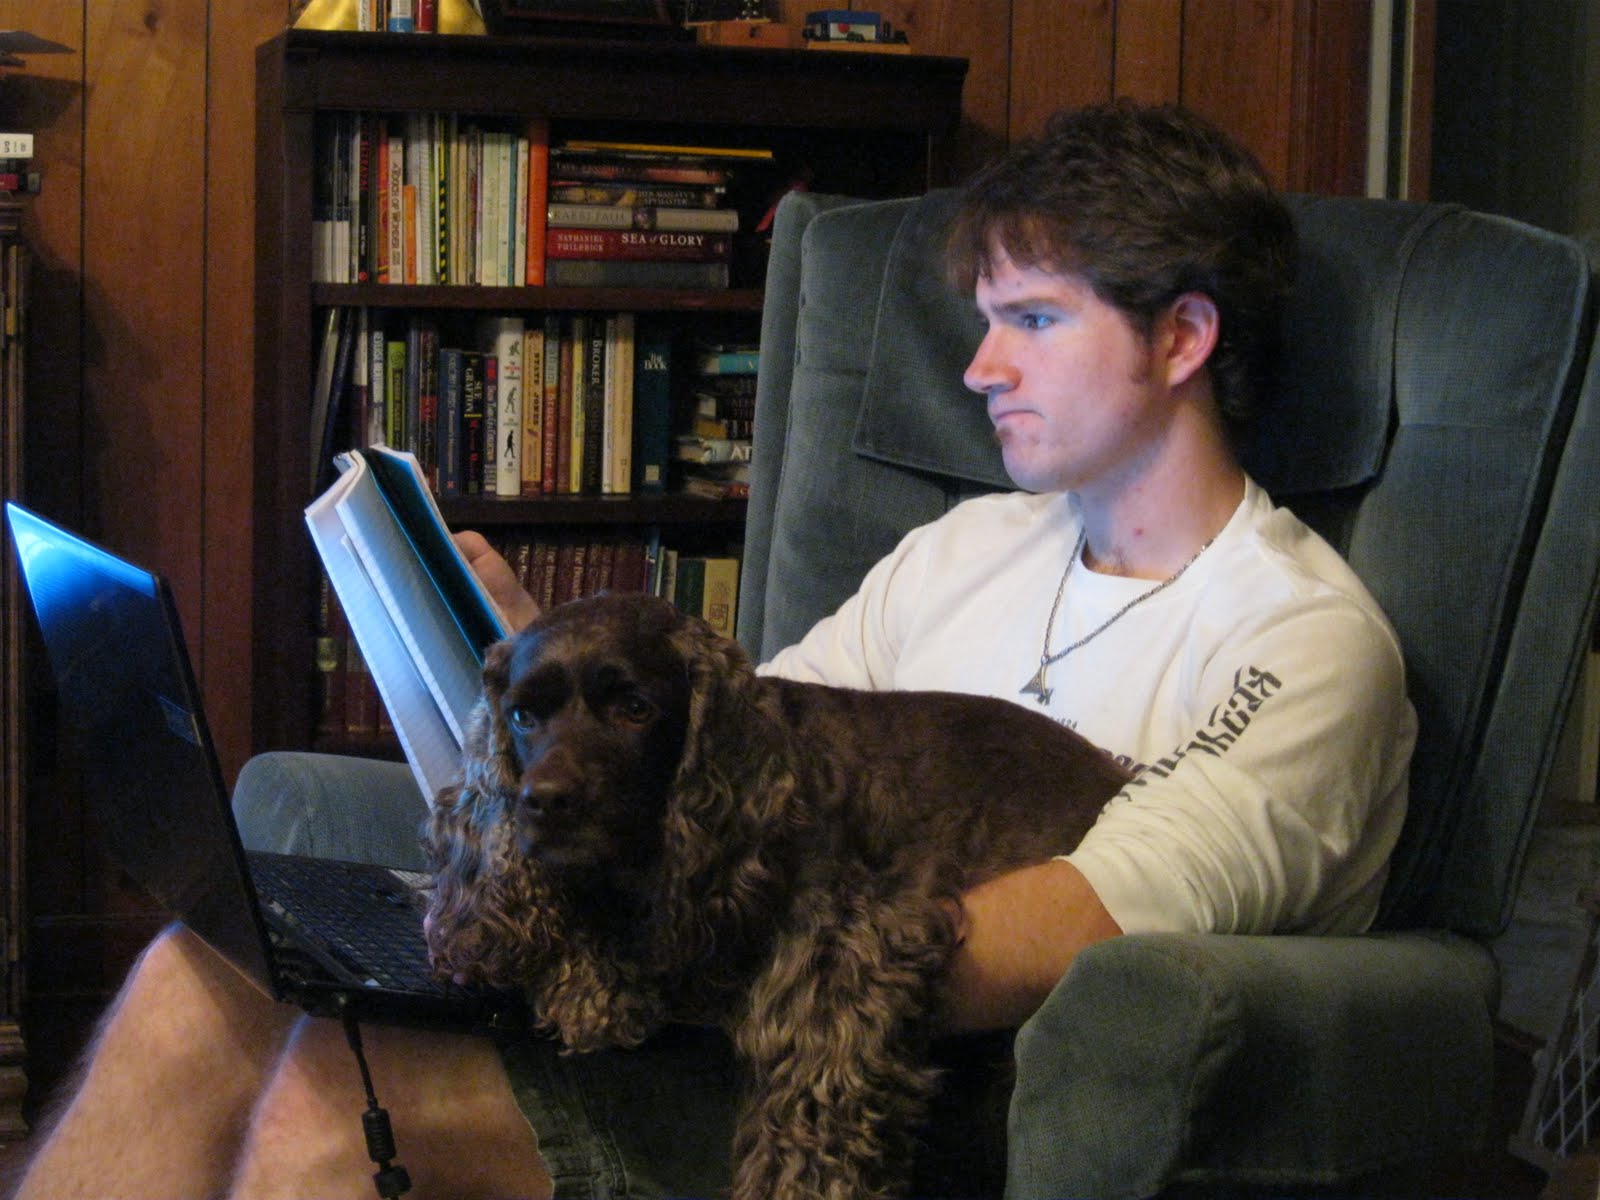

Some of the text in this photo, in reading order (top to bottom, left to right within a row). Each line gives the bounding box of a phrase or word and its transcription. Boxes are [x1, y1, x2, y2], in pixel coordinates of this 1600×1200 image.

[621, 234, 647, 245] SEA
[659, 234, 704, 247] GLORY
[591, 339, 603, 385] BROKER
[464, 367, 474, 413] GRAFTON
[474, 380, 483, 400] SUE
